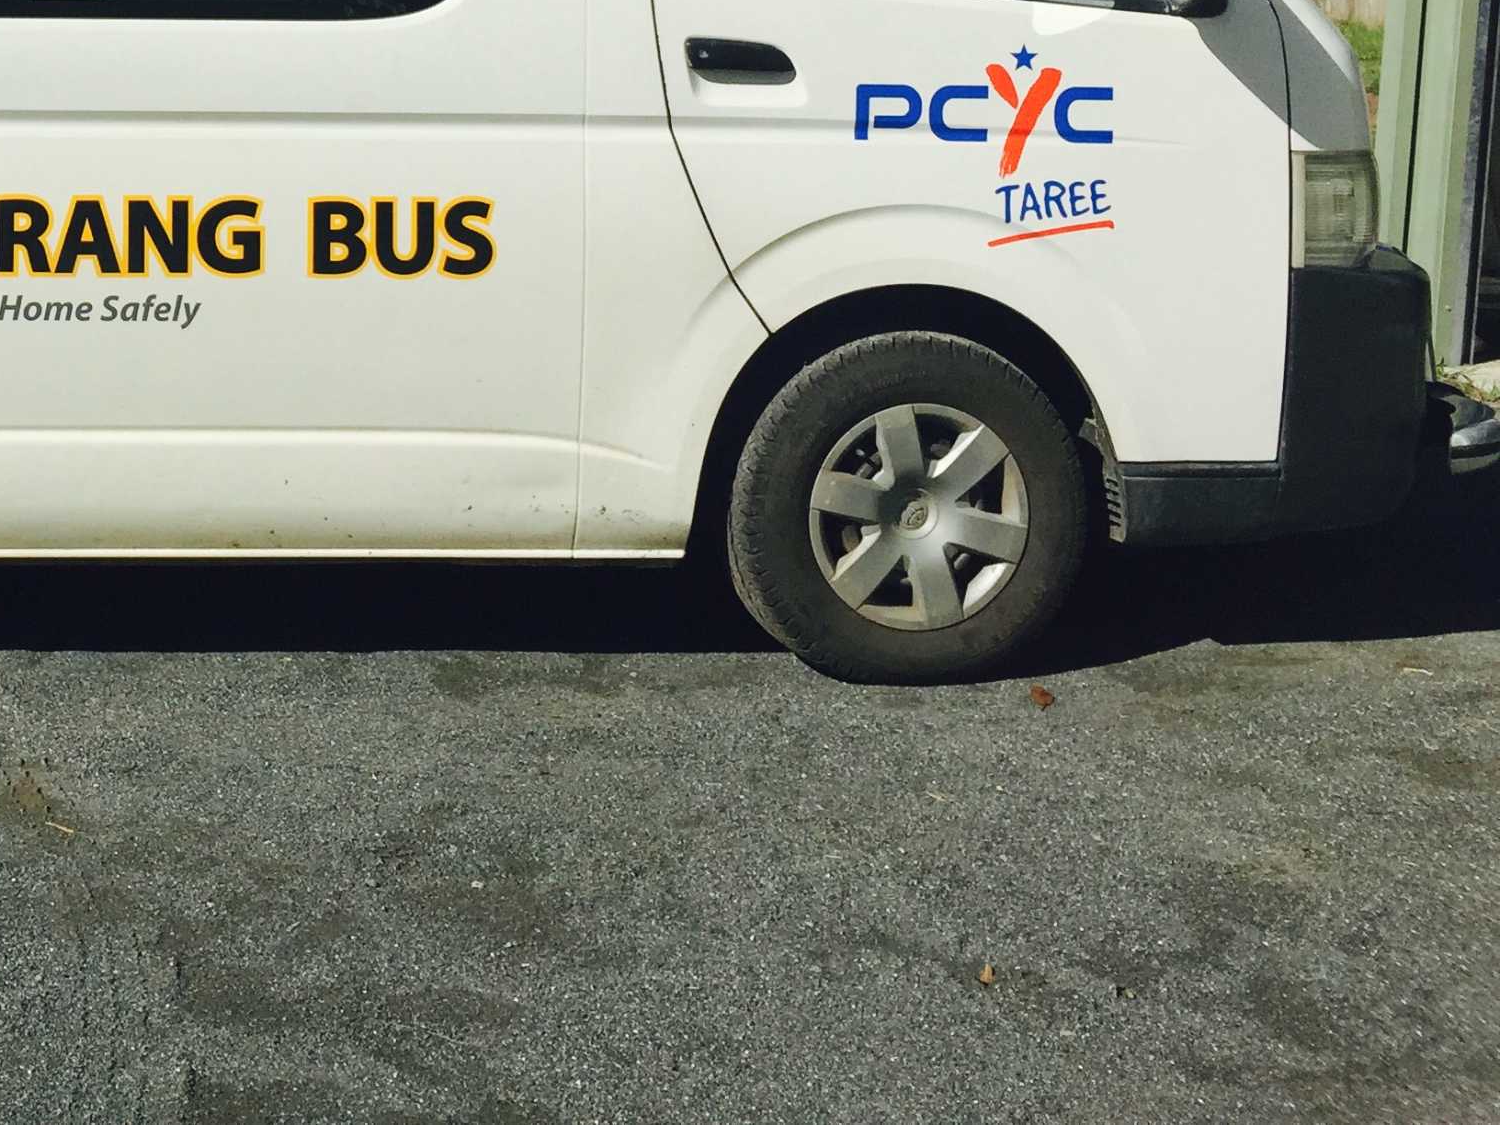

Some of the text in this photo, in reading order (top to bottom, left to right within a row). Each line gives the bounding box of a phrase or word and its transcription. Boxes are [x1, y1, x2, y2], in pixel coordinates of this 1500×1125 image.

[854, 63, 1114, 177] PCYC
[995, 179, 1111, 223] TAREE
[305, 194, 498, 281] BUS
[100, 294, 202, 330] Safely
